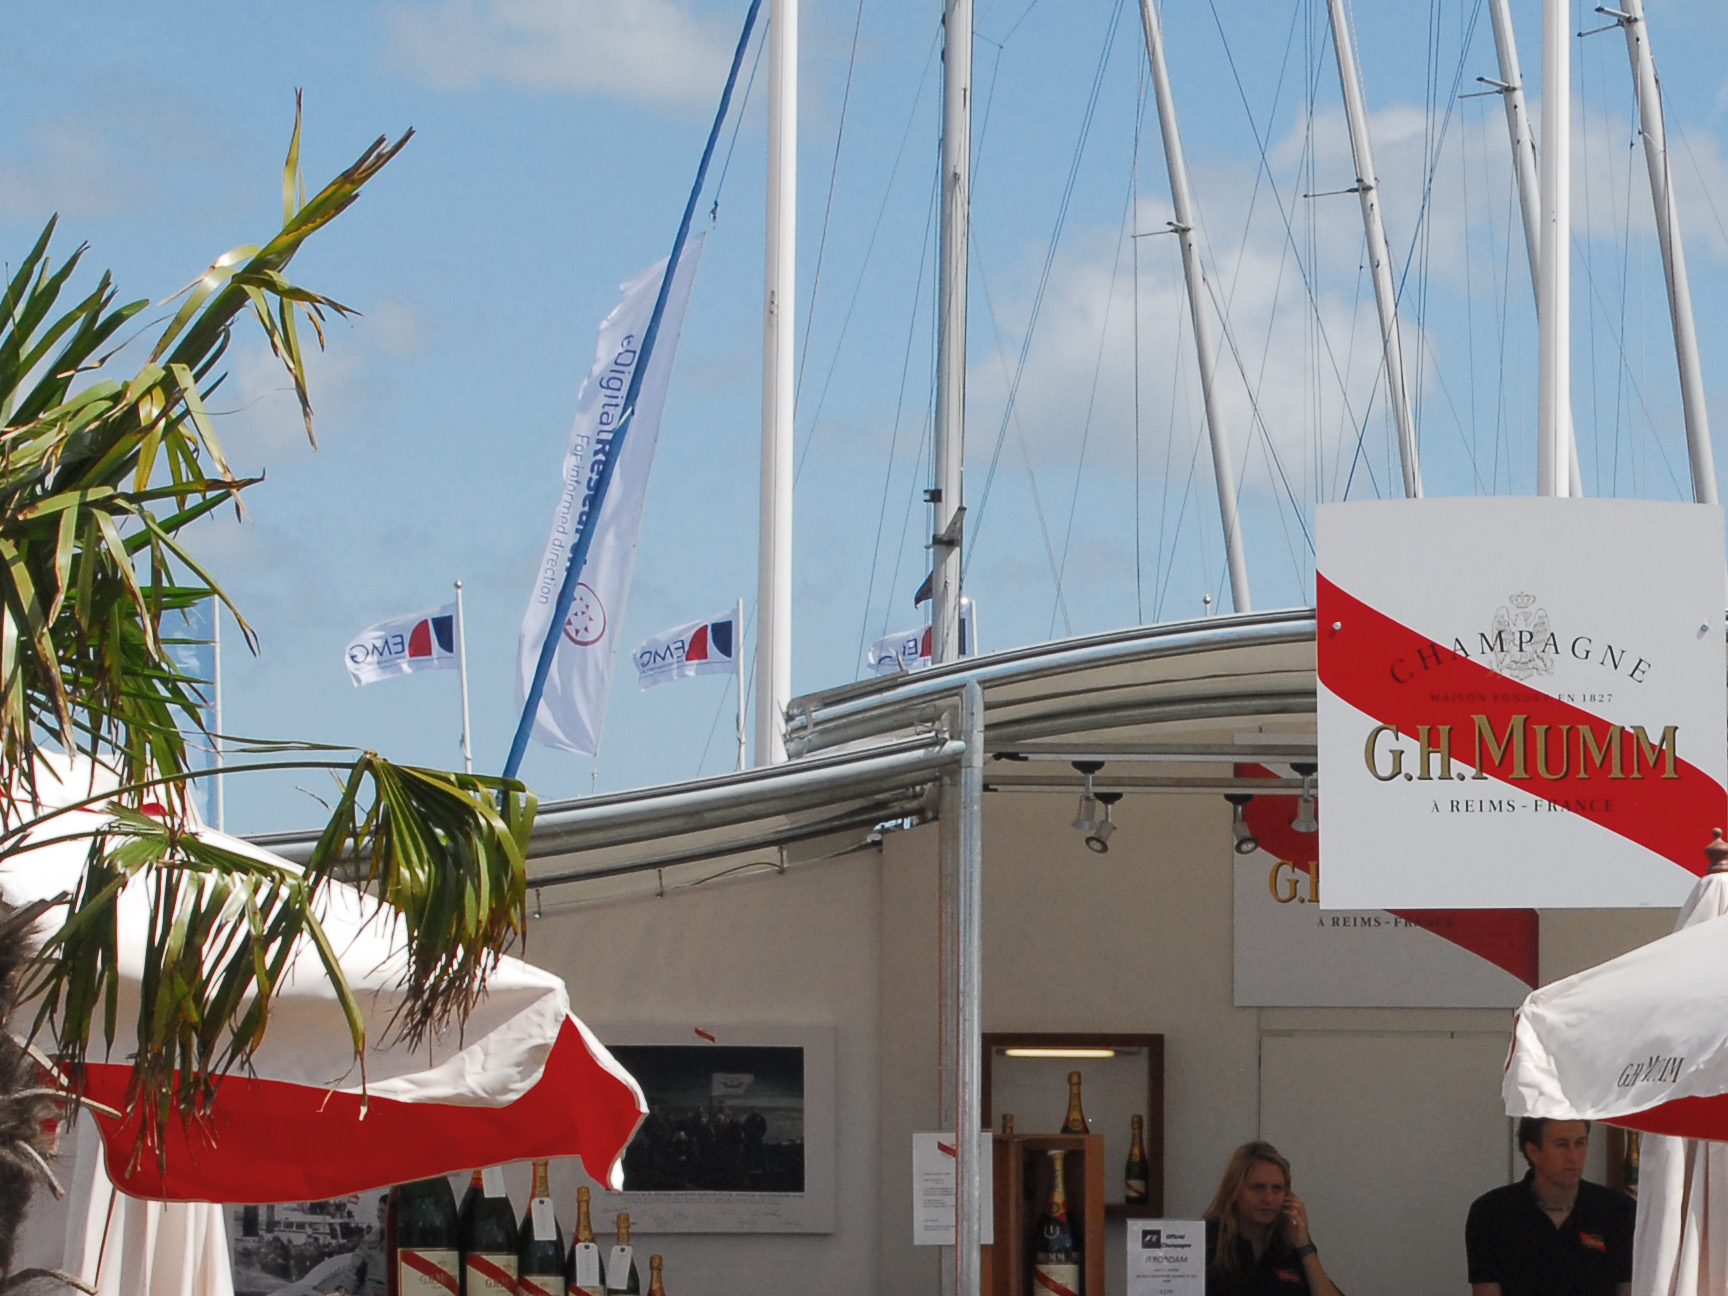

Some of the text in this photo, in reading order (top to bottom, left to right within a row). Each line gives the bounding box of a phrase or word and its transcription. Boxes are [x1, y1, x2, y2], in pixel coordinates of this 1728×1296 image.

[539, 433, 590, 605] For informed direction
[1389, 629, 1652, 686] CHAMPAGNE
[1557, 693, 1576, 703] EN
[1581, 693, 1613, 703] 1827
